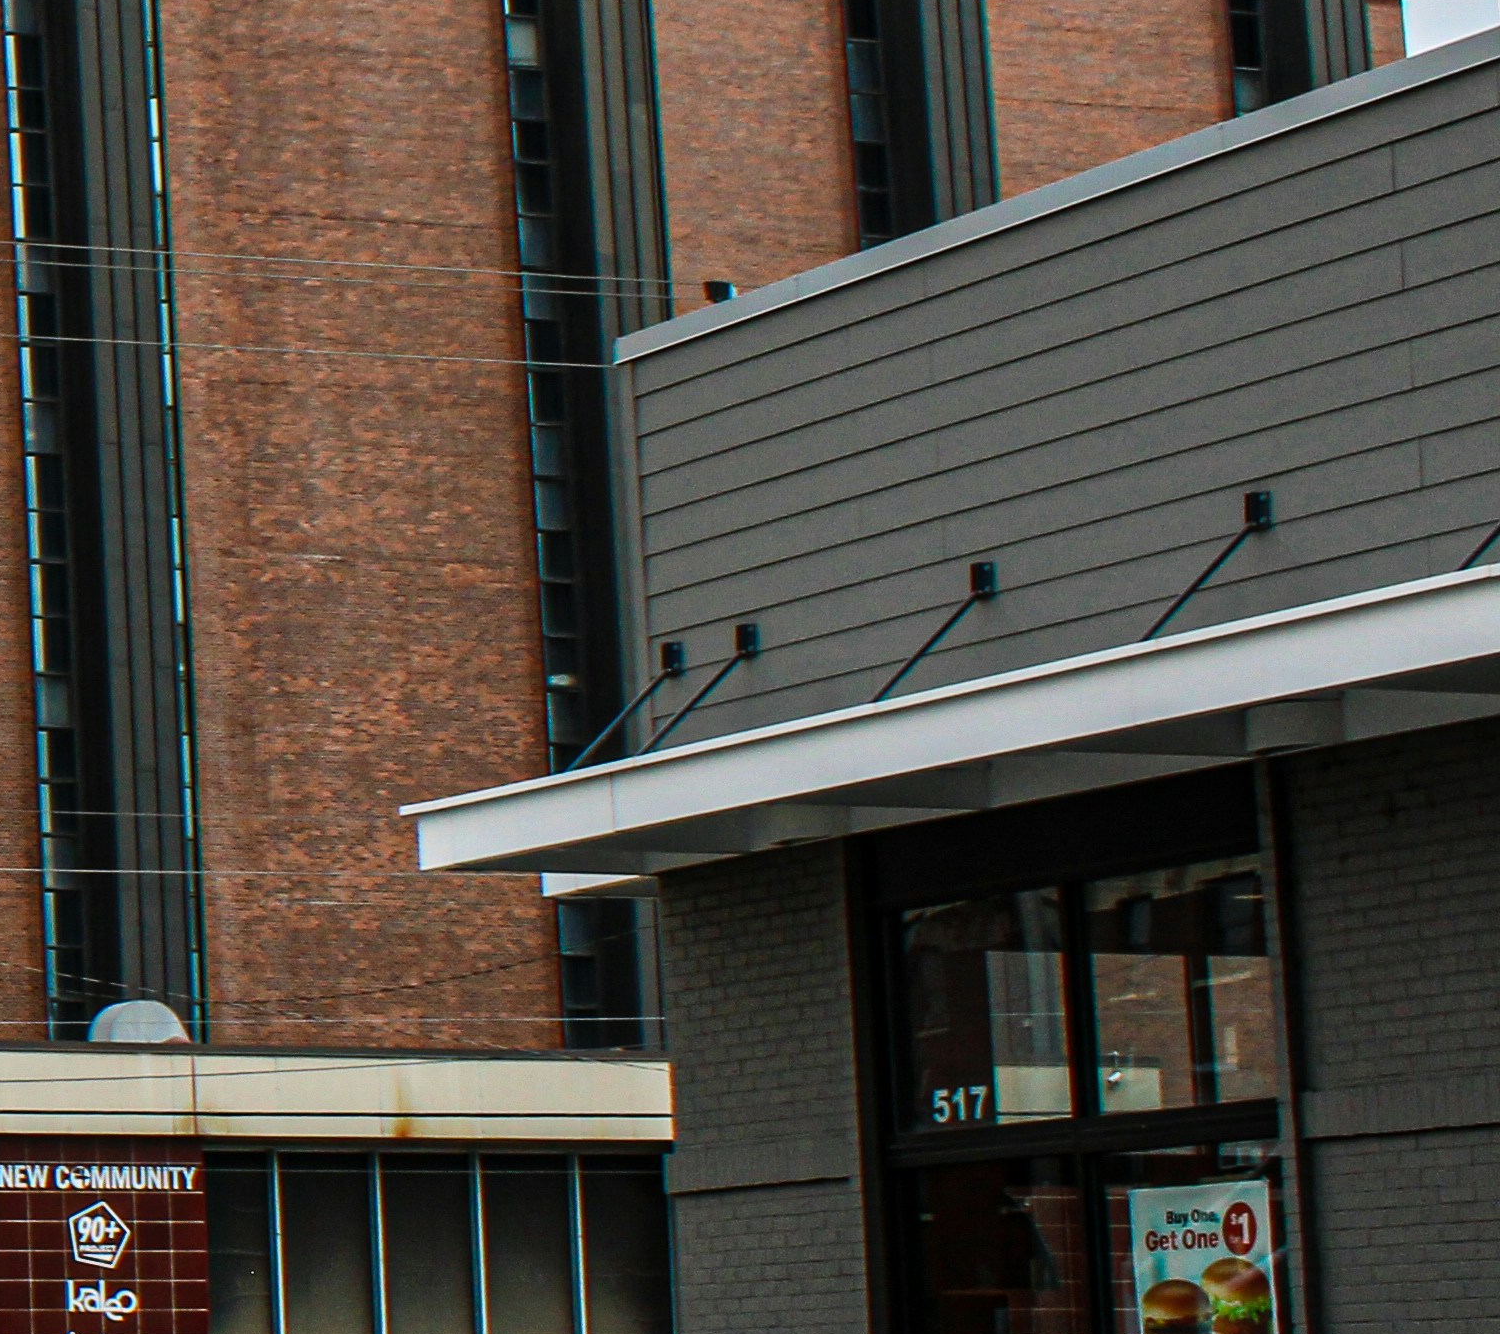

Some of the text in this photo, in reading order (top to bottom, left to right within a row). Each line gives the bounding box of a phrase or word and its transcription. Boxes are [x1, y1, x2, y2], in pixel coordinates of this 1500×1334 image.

[932, 1086, 987, 1123] 517
[55, 1165, 197, 1190] COMMUNITY
[77, 1216, 121, 1243] 90+
[1166, 1209, 1189, 1227] Buy
[1145, 1229, 1179, 1252] Get
[1181, 1228, 1219, 1249] One
